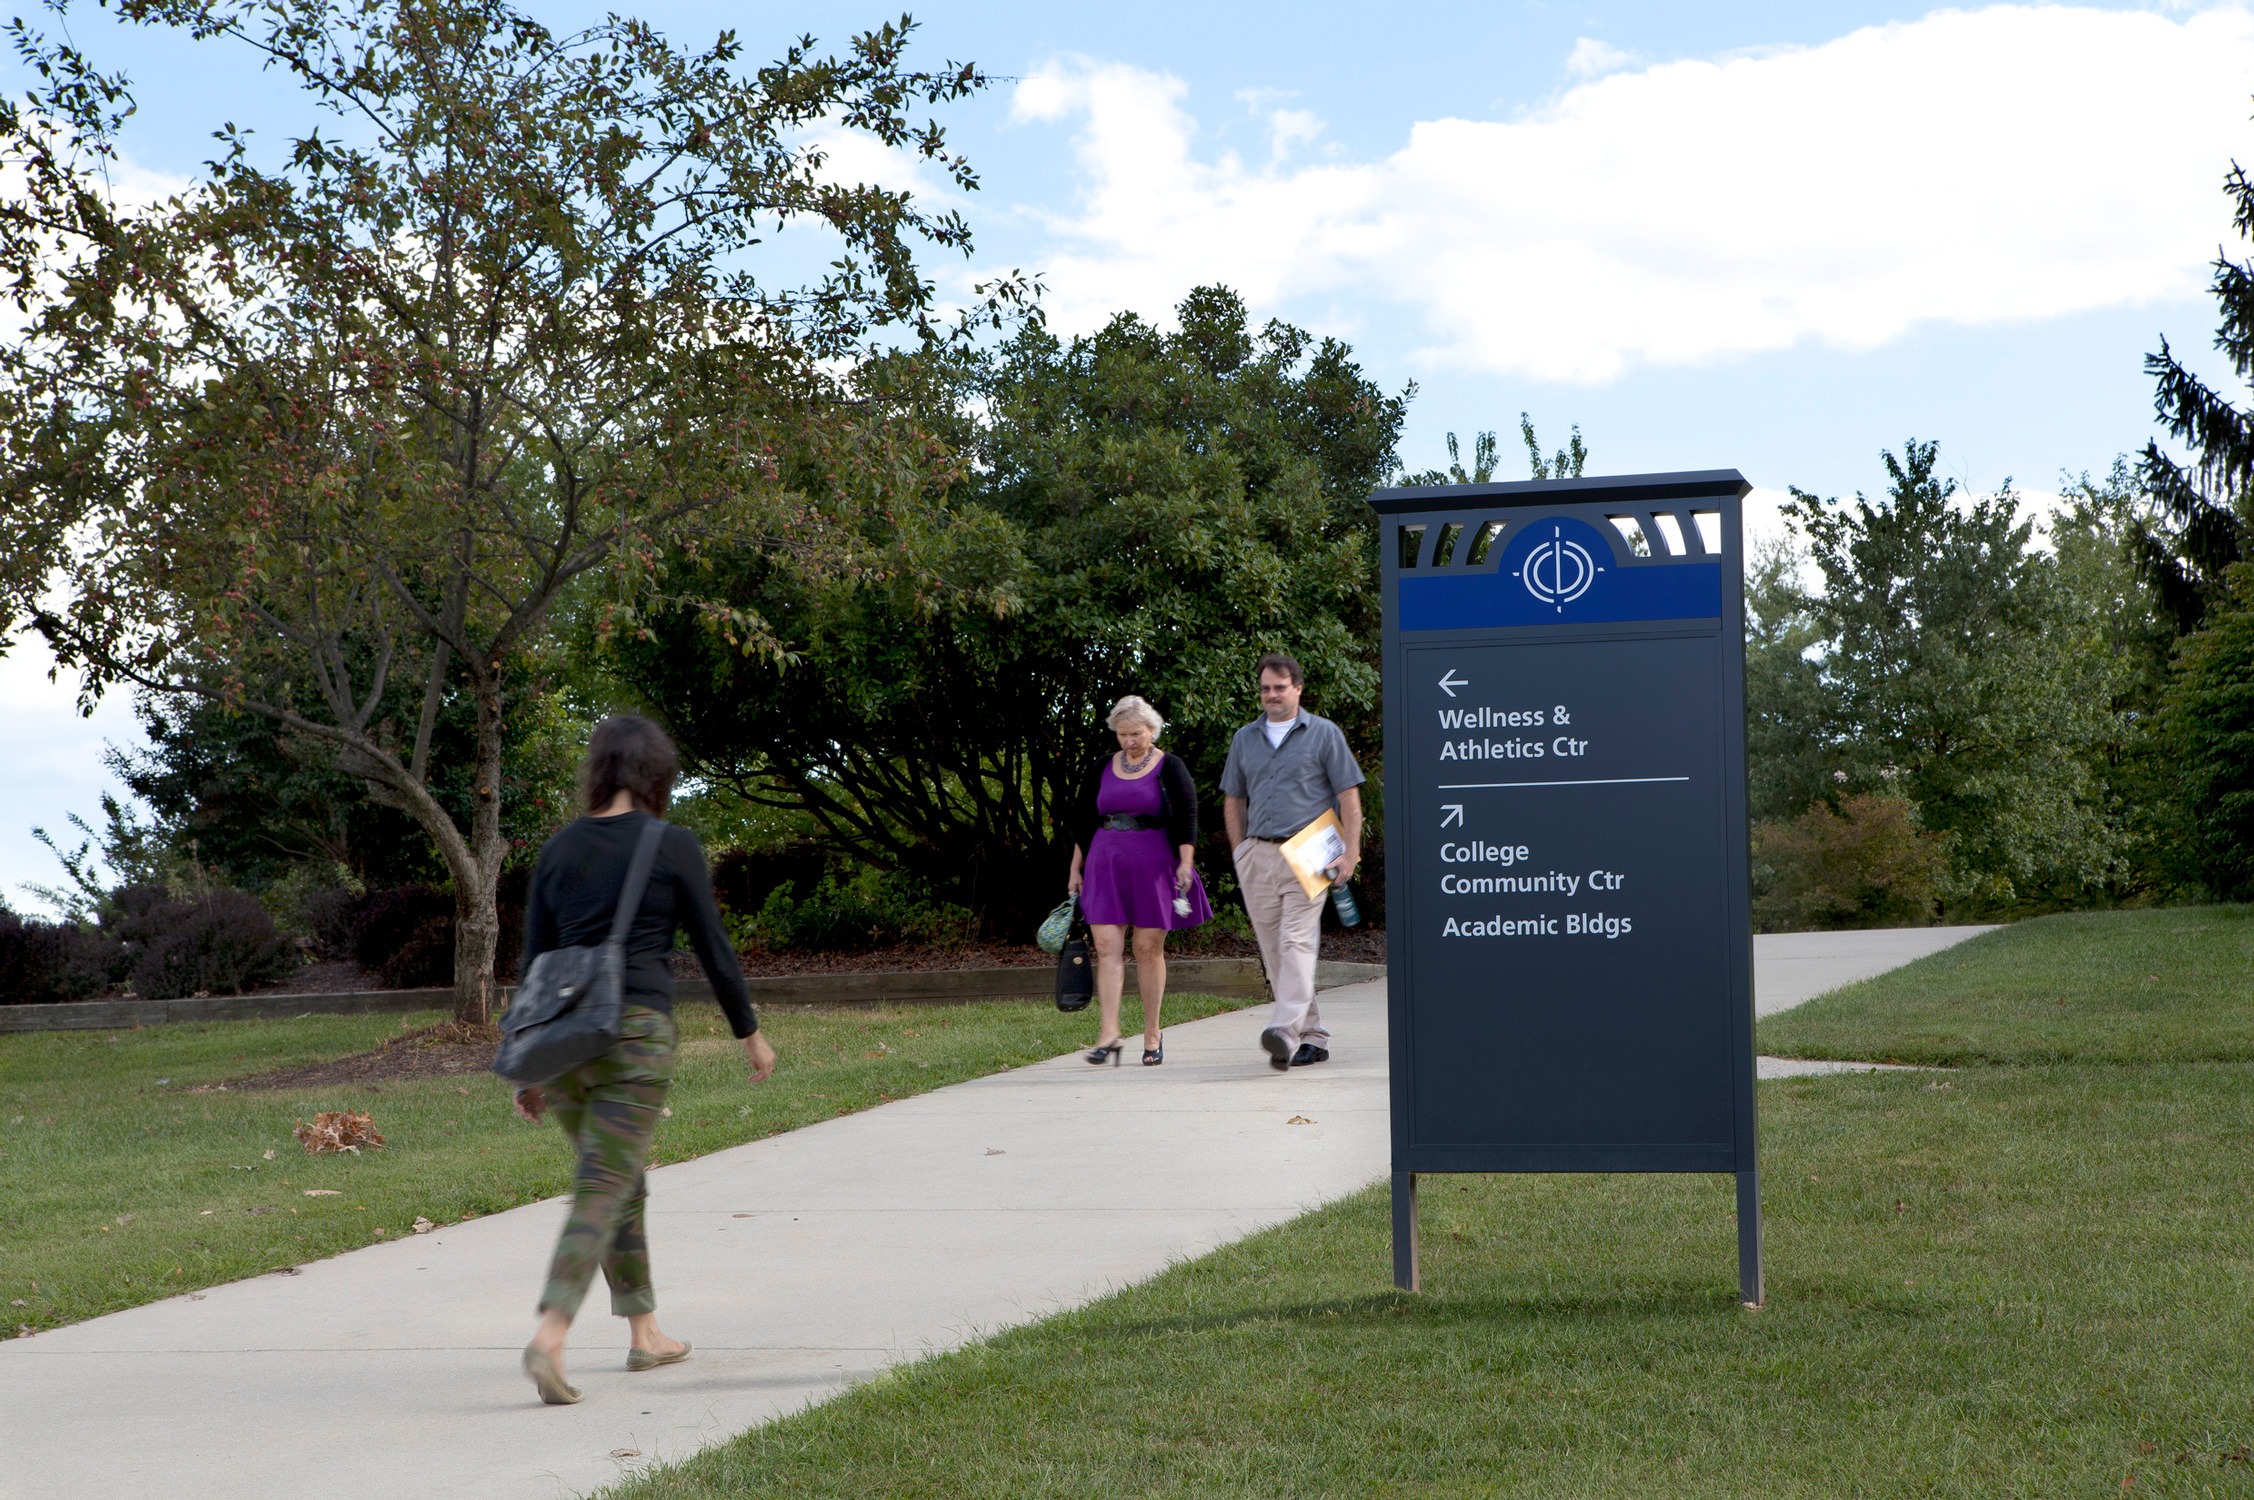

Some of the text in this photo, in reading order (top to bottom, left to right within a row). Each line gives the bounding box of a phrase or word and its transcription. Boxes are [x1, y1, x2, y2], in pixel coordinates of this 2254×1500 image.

[1437, 704, 1571, 730] Wellness &
[1439, 736, 1589, 761] Athletics Ctr
[1440, 840, 1530, 867] College
[1440, 869, 1625, 897] Community Ctr
[1441, 912, 1633, 940] Academic Bldgs
